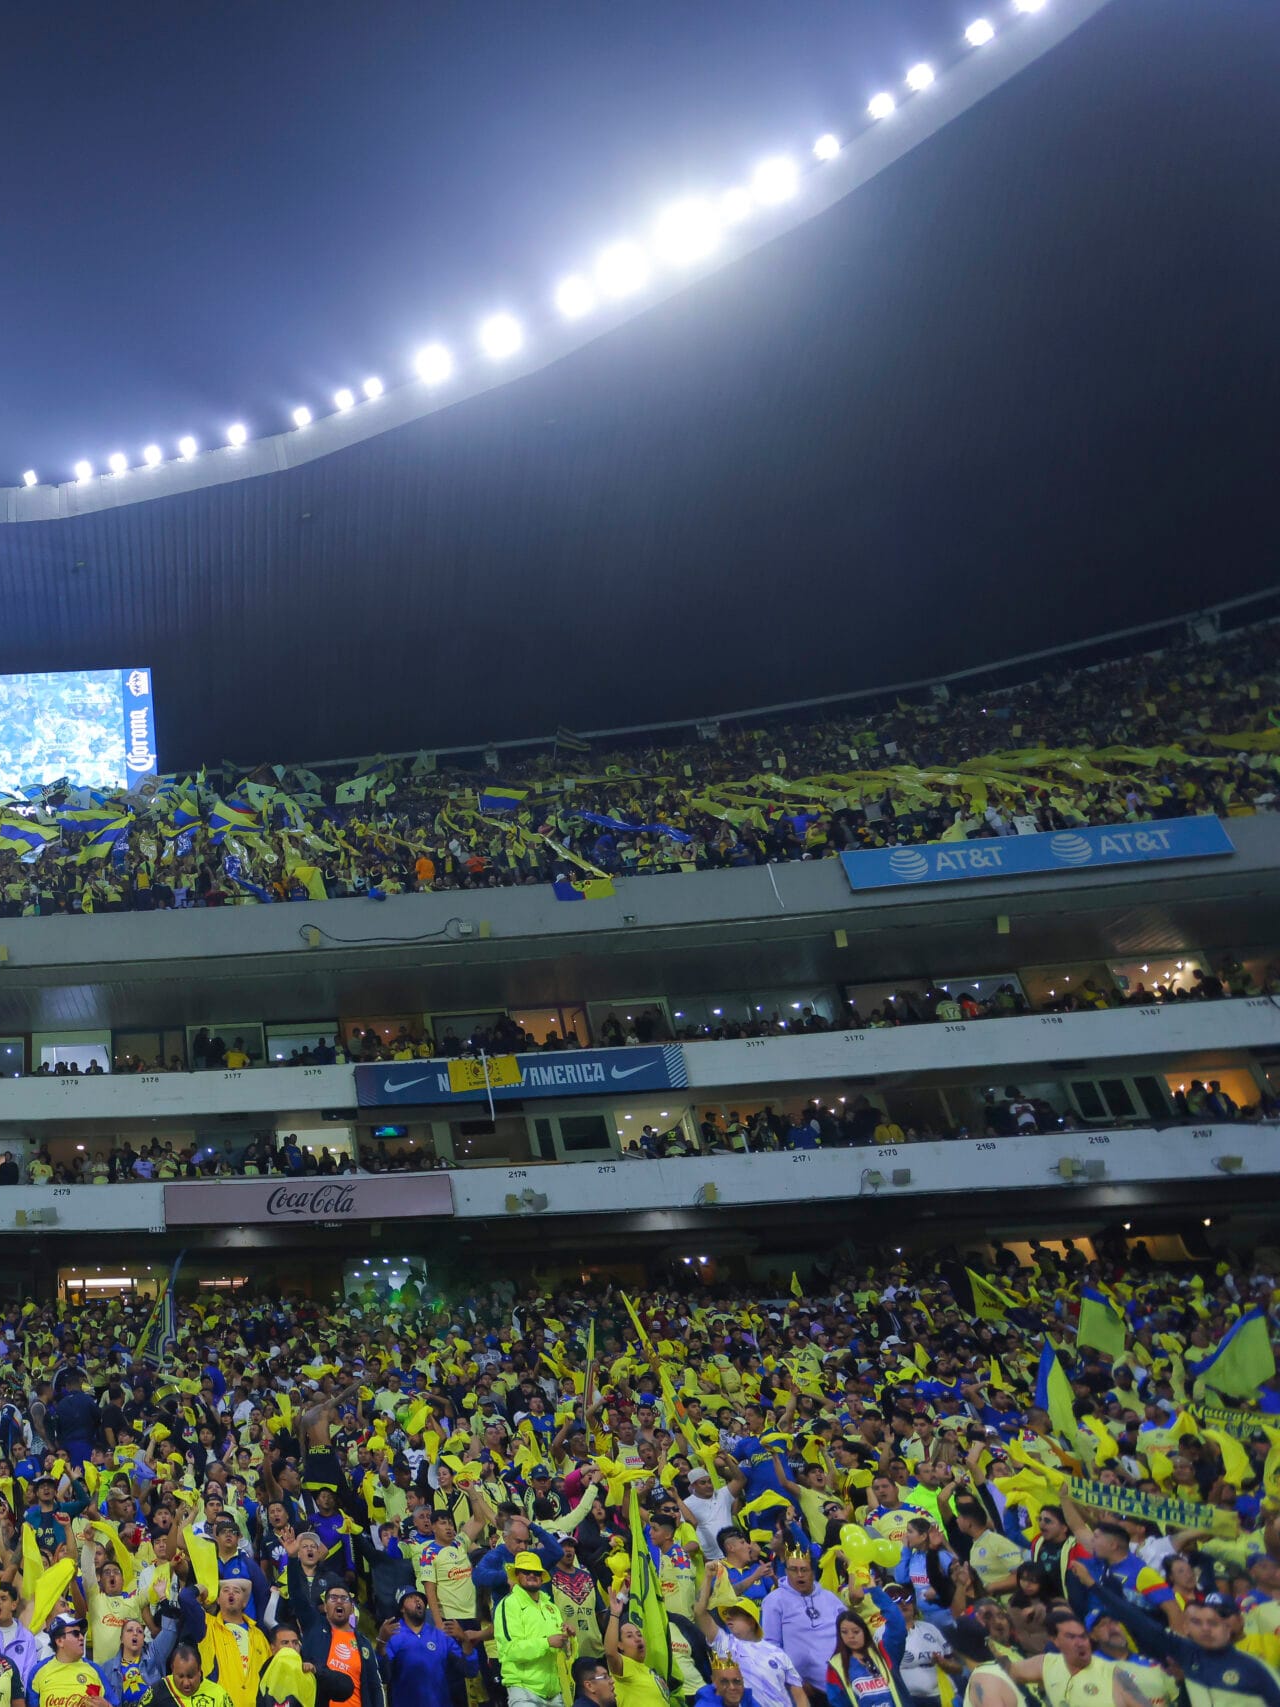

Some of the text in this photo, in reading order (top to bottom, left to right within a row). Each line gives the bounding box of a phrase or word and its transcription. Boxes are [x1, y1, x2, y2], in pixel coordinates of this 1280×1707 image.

[126, 708, 157, 772] Corona
[936, 829, 1171, 872] AT&T AT&T
[844, 1034, 865, 1042] 3170
[746, 1040, 765, 1048] 3171
[1087, 1135, 1110, 1144] 2168
[975, 1142, 996, 1151] 2169
[878, 1149, 898, 1157] 2170
[597, 1166, 616, 1174] 2173
[53, 1188, 70, 1196] 2179
[267, 1184, 357, 1215] Coca-Cola
[576, 1607, 593, 1616] AT&T
[329, 1658, 351, 1672] AT&T
